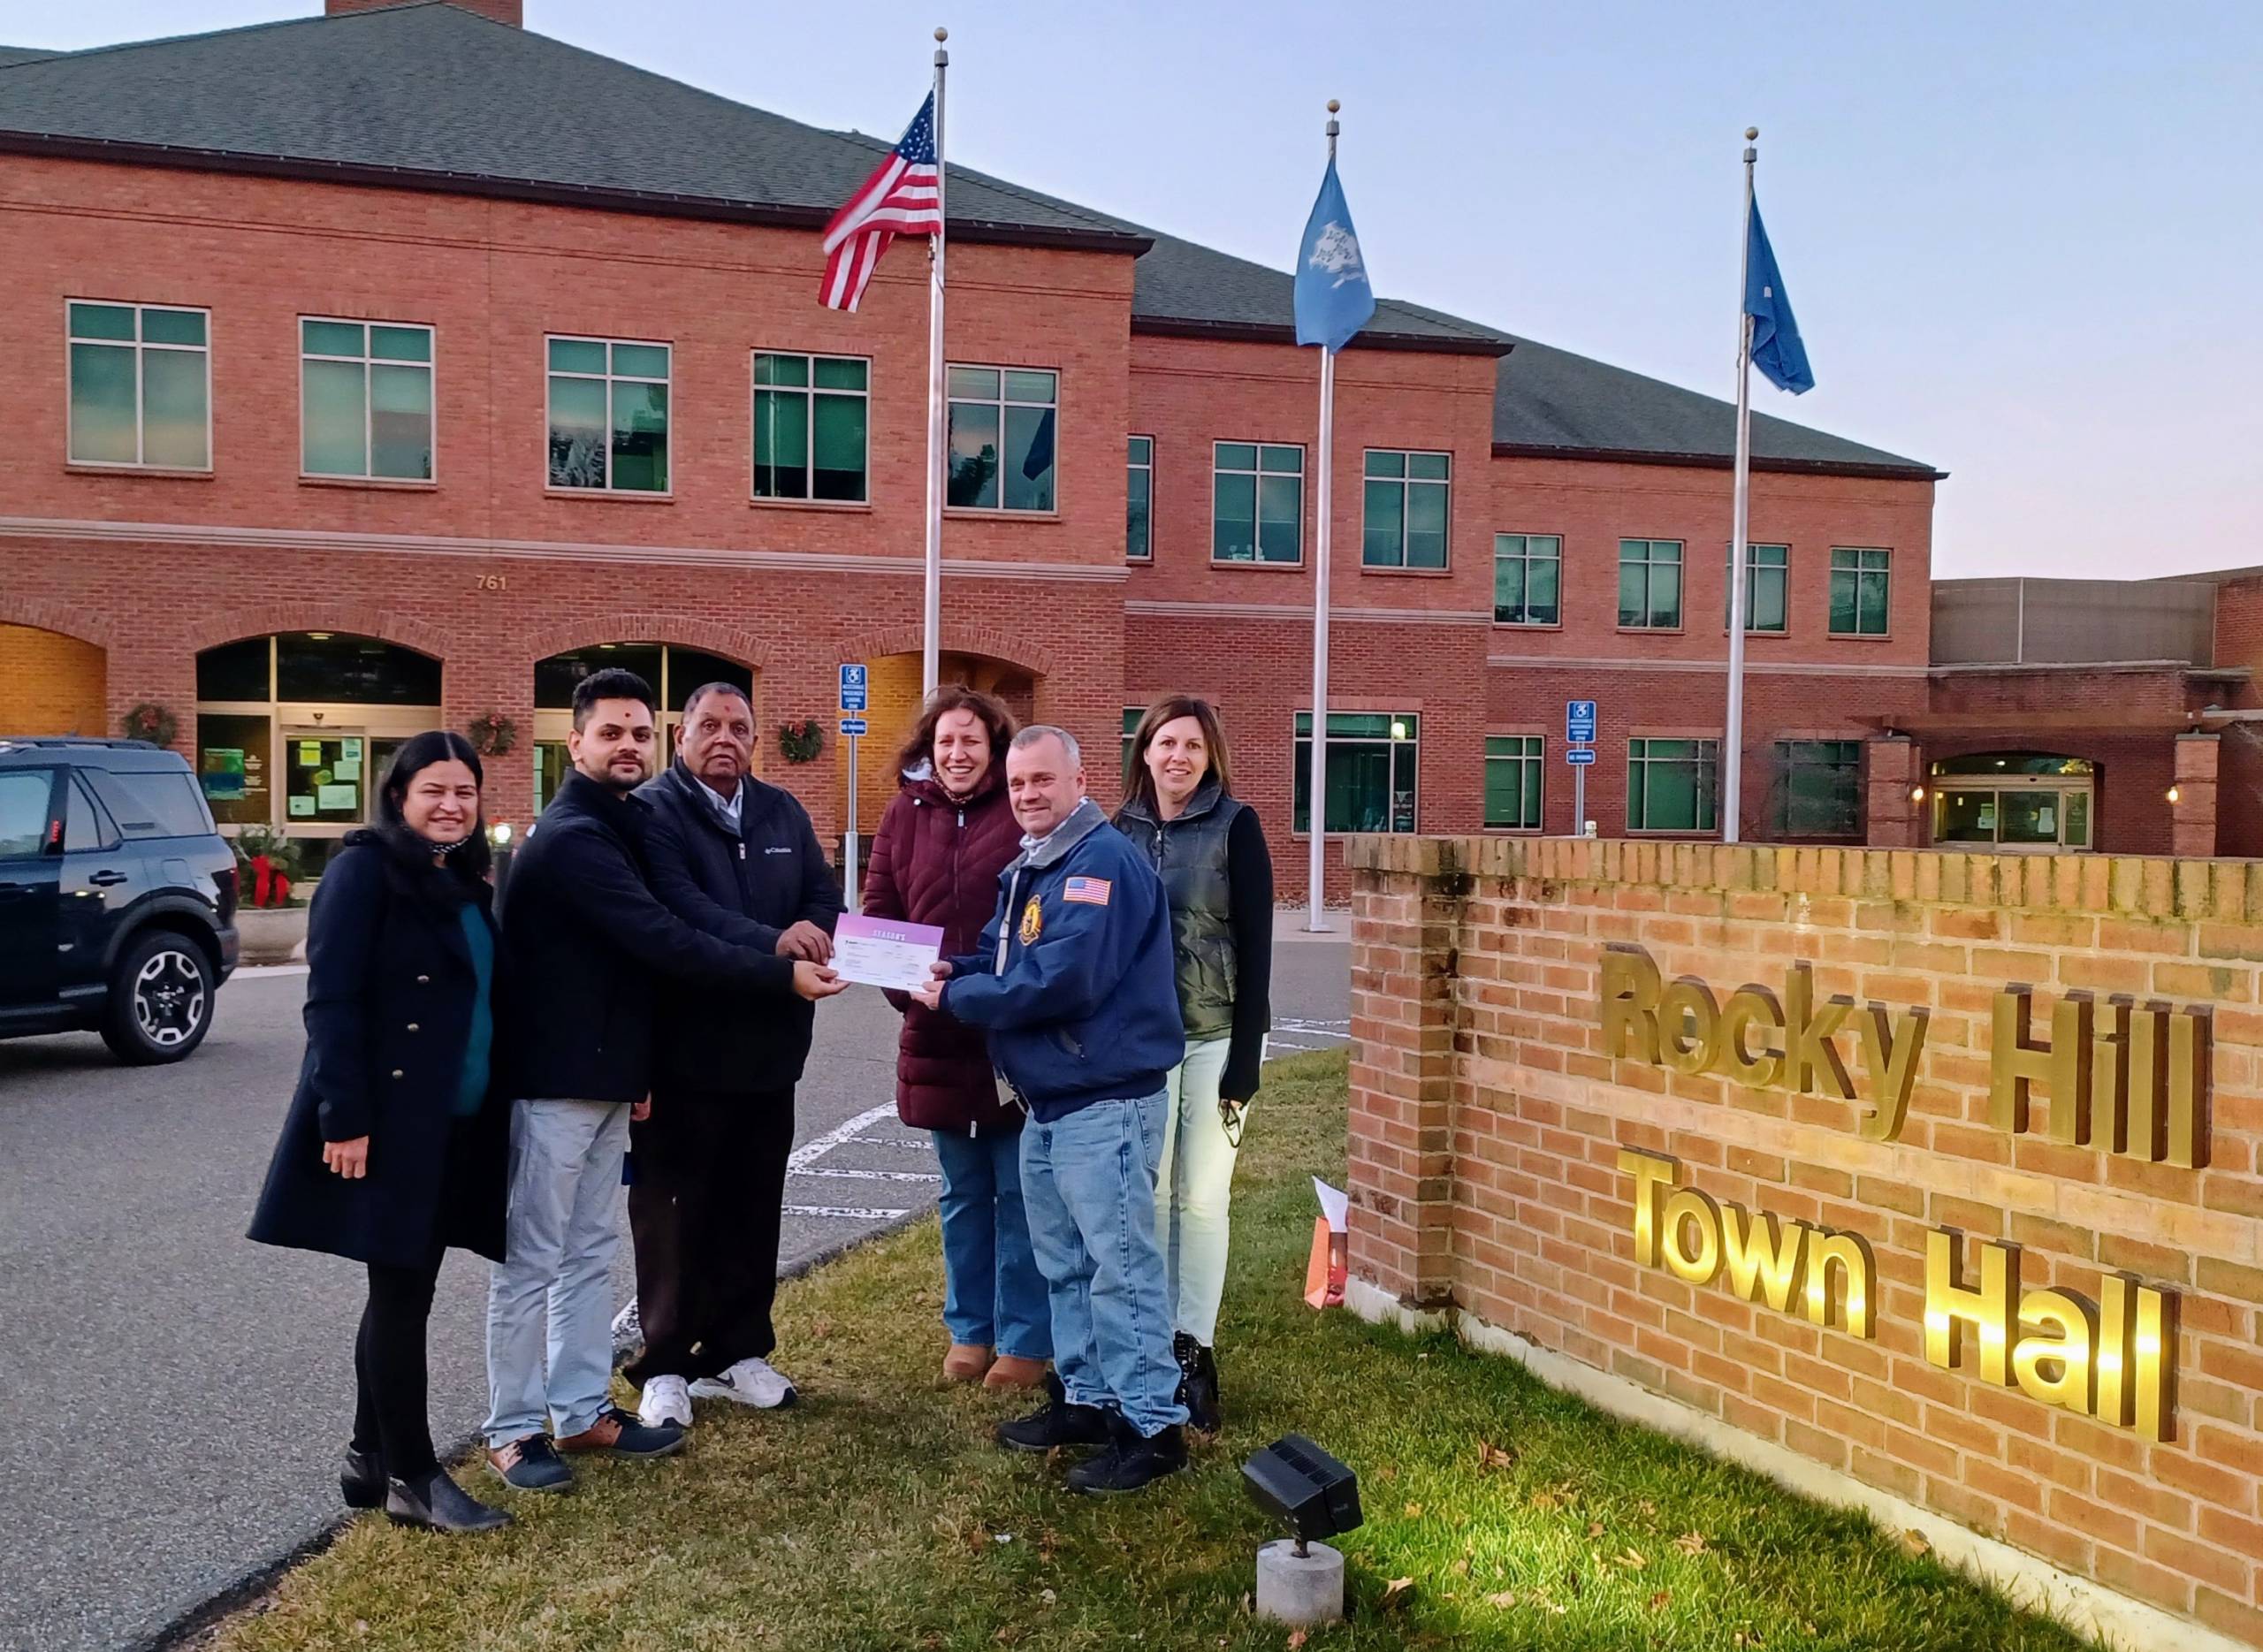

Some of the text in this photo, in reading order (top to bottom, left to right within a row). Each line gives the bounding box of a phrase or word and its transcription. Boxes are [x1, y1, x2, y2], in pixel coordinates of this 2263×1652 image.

[476, 575, 507, 590] 761
[1600, 943, 2213, 1169] Rocky Hill
[1617, 1146, 2182, 1443] Town Hall
